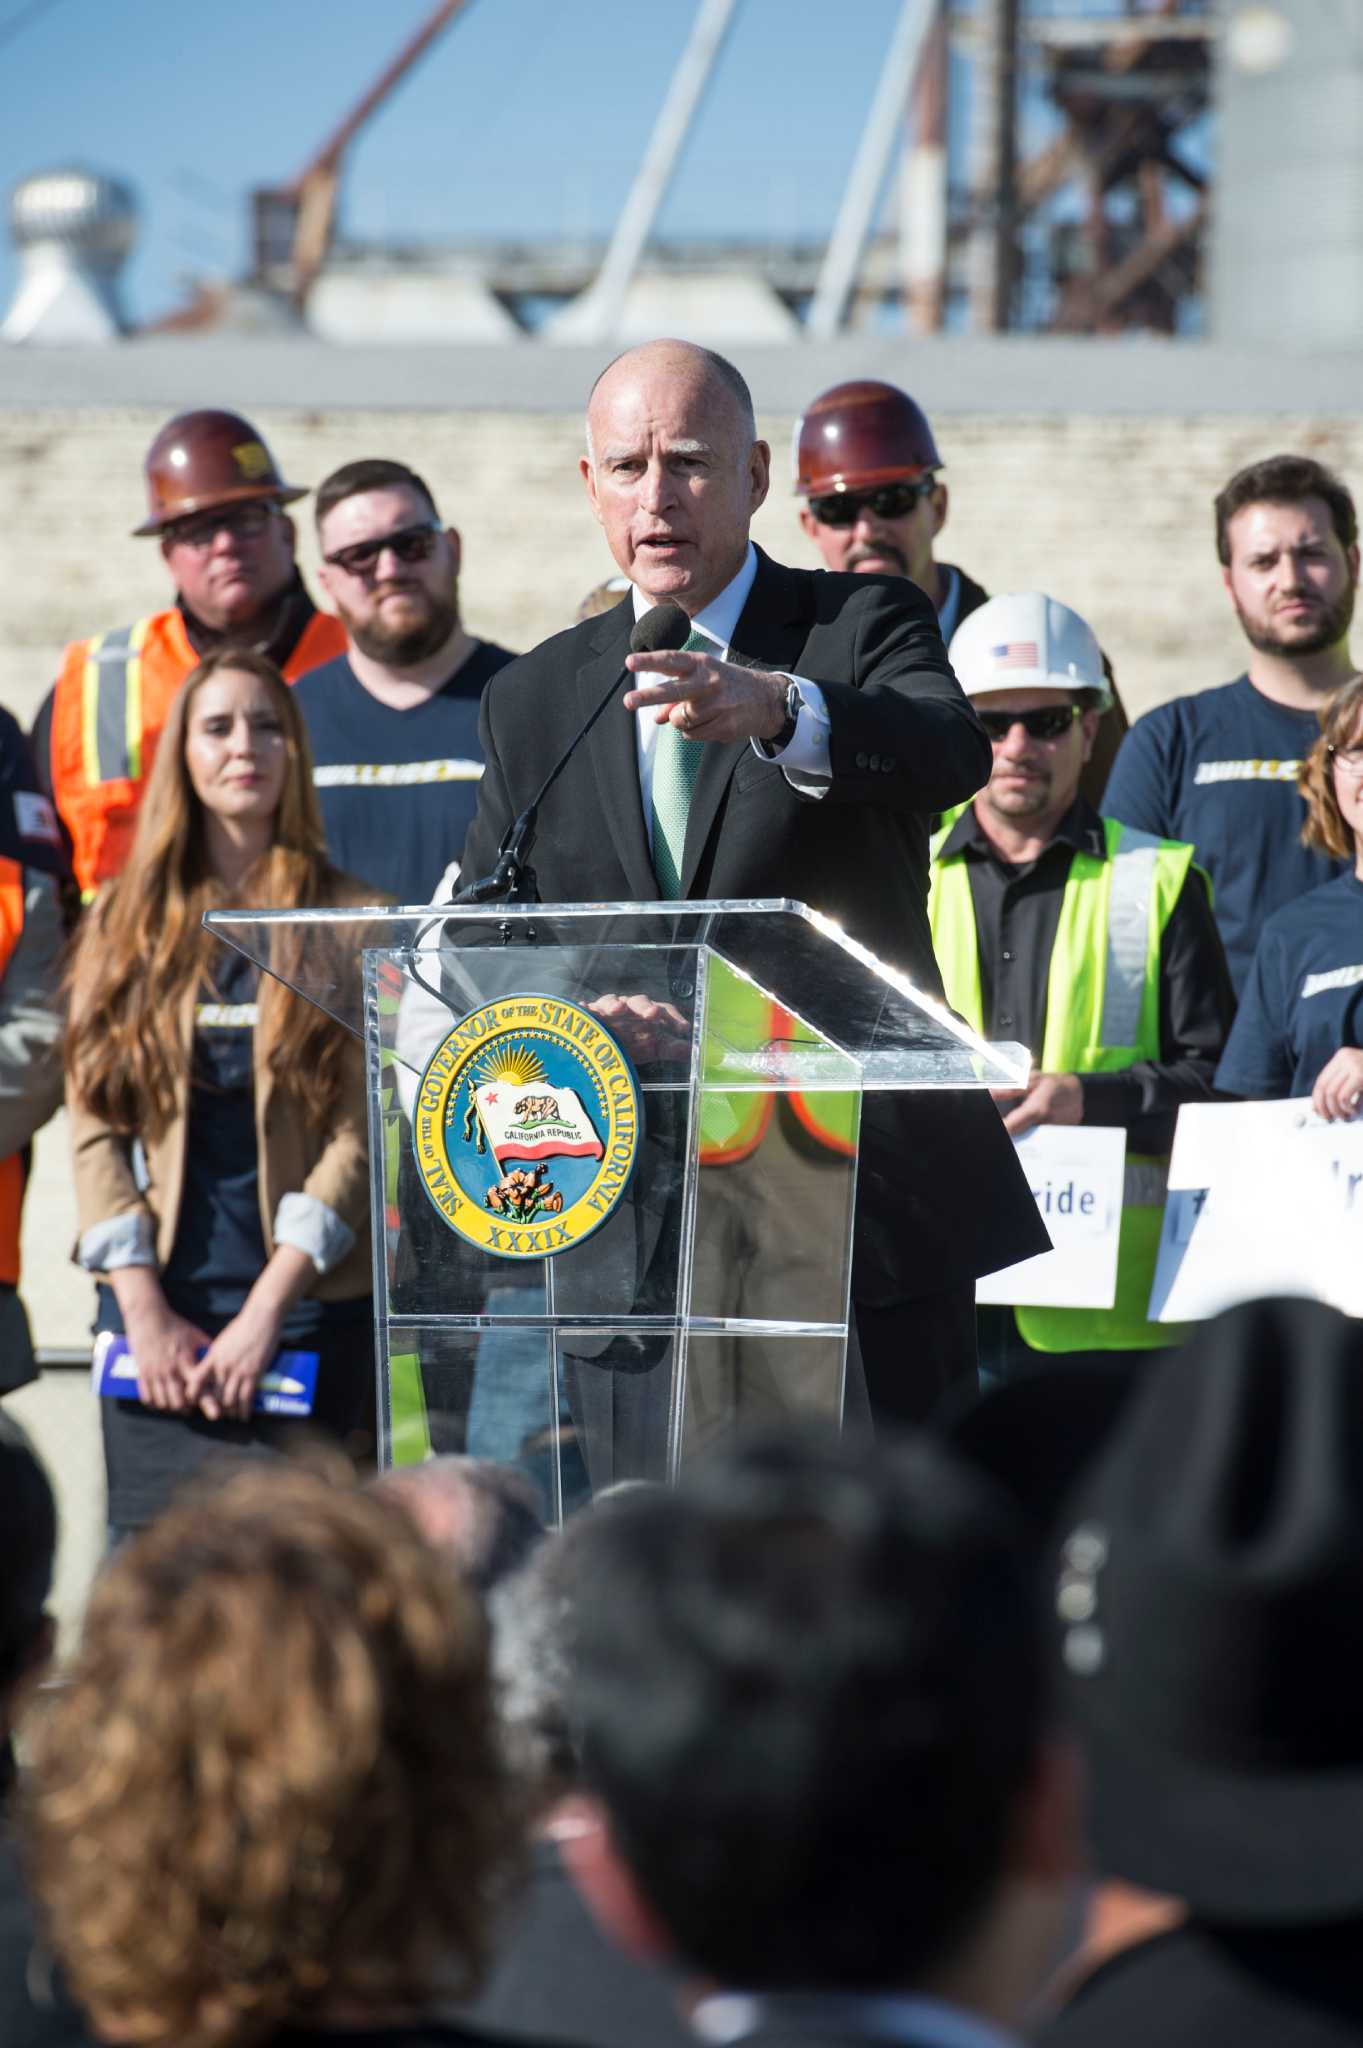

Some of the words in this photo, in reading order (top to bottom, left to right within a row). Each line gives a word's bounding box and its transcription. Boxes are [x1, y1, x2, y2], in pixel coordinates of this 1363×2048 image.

[501, 1006, 514, 1018] OF
[516, 1004, 537, 1017] THE
[538, 1002, 600, 1048] STATE
[421, 1007, 501, 1112] GOVERNOR
[593, 1042, 621, 1073] OF
[422, 1117, 432, 1140] THE
[504, 1129, 546, 1141] CALIFORNIA
[547, 1127, 583, 1140] REPUBLIC
[586, 1072, 634, 1213] CALIFORNIA
[422, 1144, 434, 1158] OF
[426, 1159, 464, 1217] SEAL
[486, 1220, 574, 1252] XXXIX
